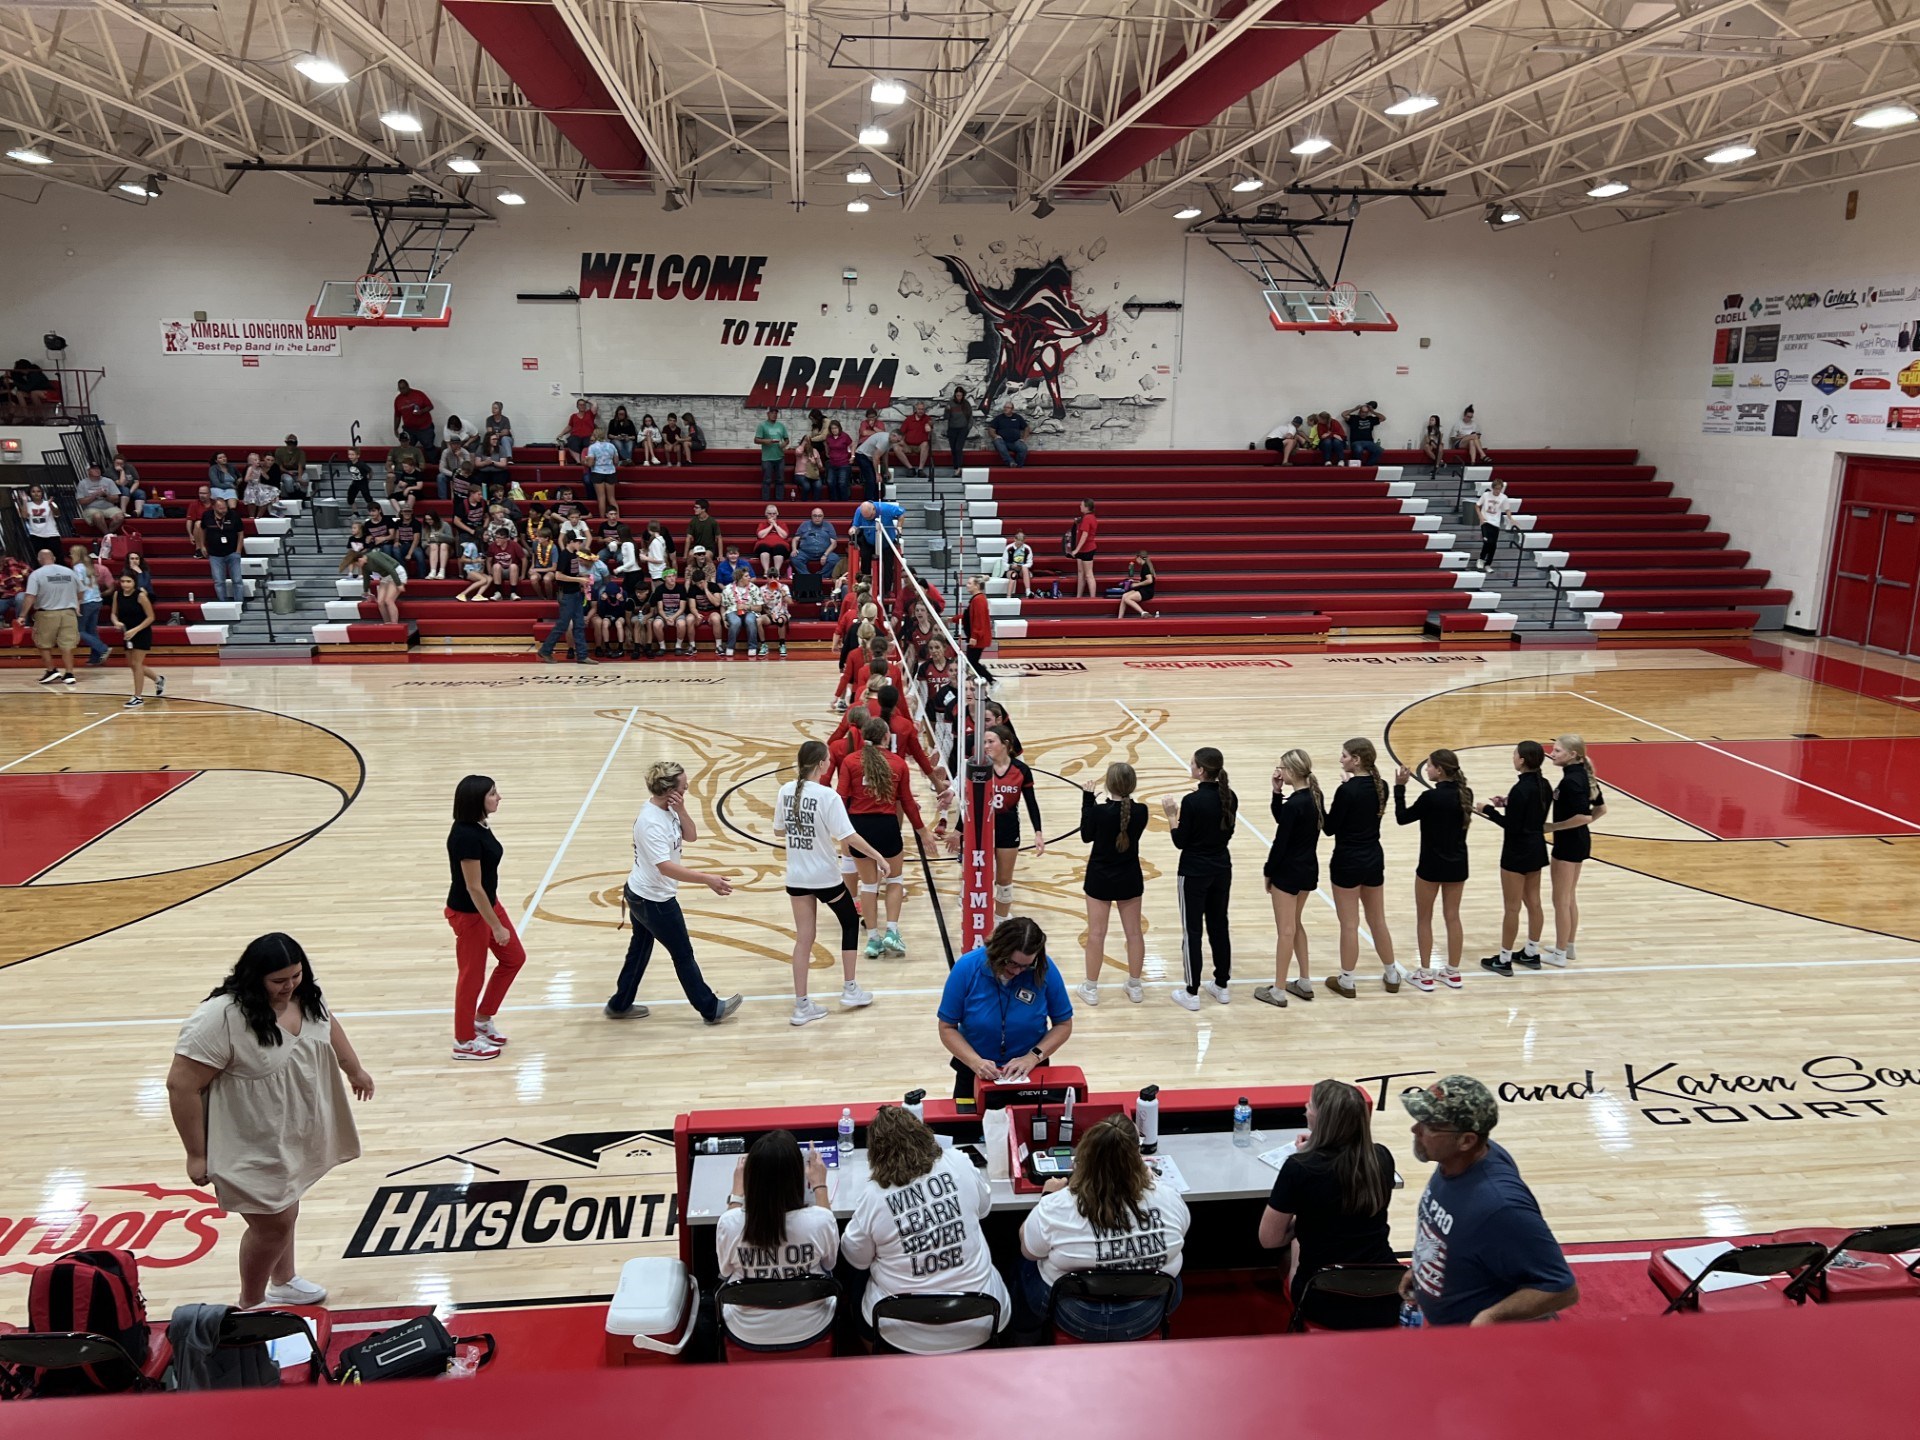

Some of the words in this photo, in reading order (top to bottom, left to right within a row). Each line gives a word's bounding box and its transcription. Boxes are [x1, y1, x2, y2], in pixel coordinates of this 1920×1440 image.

[579, 252, 768, 302] WELCOME
[1715, 312, 1747, 324] CROELL
[191, 322, 240, 338] KIMBALL
[242, 323, 303, 339] LONGHORN
[307, 325, 337, 340] BAND
[720, 318, 749, 346] TO
[753, 321, 798, 346] THE
[165, 333, 177, 351] K
[223, 342, 242, 352] Pep
[245, 342, 271, 351] Band
[275, 343, 284, 351] in
[287, 343, 303, 352] the
[1856, 338, 1874, 350] HIGH
[1875, 337, 1898, 348] POINT
[743, 355, 899, 409] ARENA
[1811, 415, 1819, 424] R
[1831, 415, 1838, 424] C
[989, 663, 1034, 671] CONT
[535, 679, 615, 687] Karen
[616, 678, 670, 686] and
[678, 677, 727, 686] Tom
[993, 785, 1018, 793] LORS
[802, 797, 817, 811] OR
[993, 794, 1004, 809] 8
[788, 836, 814, 850] LOSE
[969, 850, 988, 950] KIMBA
[1498, 1070, 1603, 1103] and
[1625, 1062, 1798, 1106] Karen
[1641, 1099, 1890, 1125] COURT
[886, 1182, 926, 1216] WIN
[927, 1172, 958, 1198] OR
[894, 1195, 963, 1237] LEARN
[1138, 1207, 1166, 1231] OR
[1429, 1199, 1454, 1235] PRO
[902, 1220, 966, 1254] NEVER
[1095, 1230, 1168, 1262] LEARN
[737, 1246, 780, 1267] WIN
[785, 1243, 815, 1264] OR
[910, 1245, 964, 1277] LOSE
